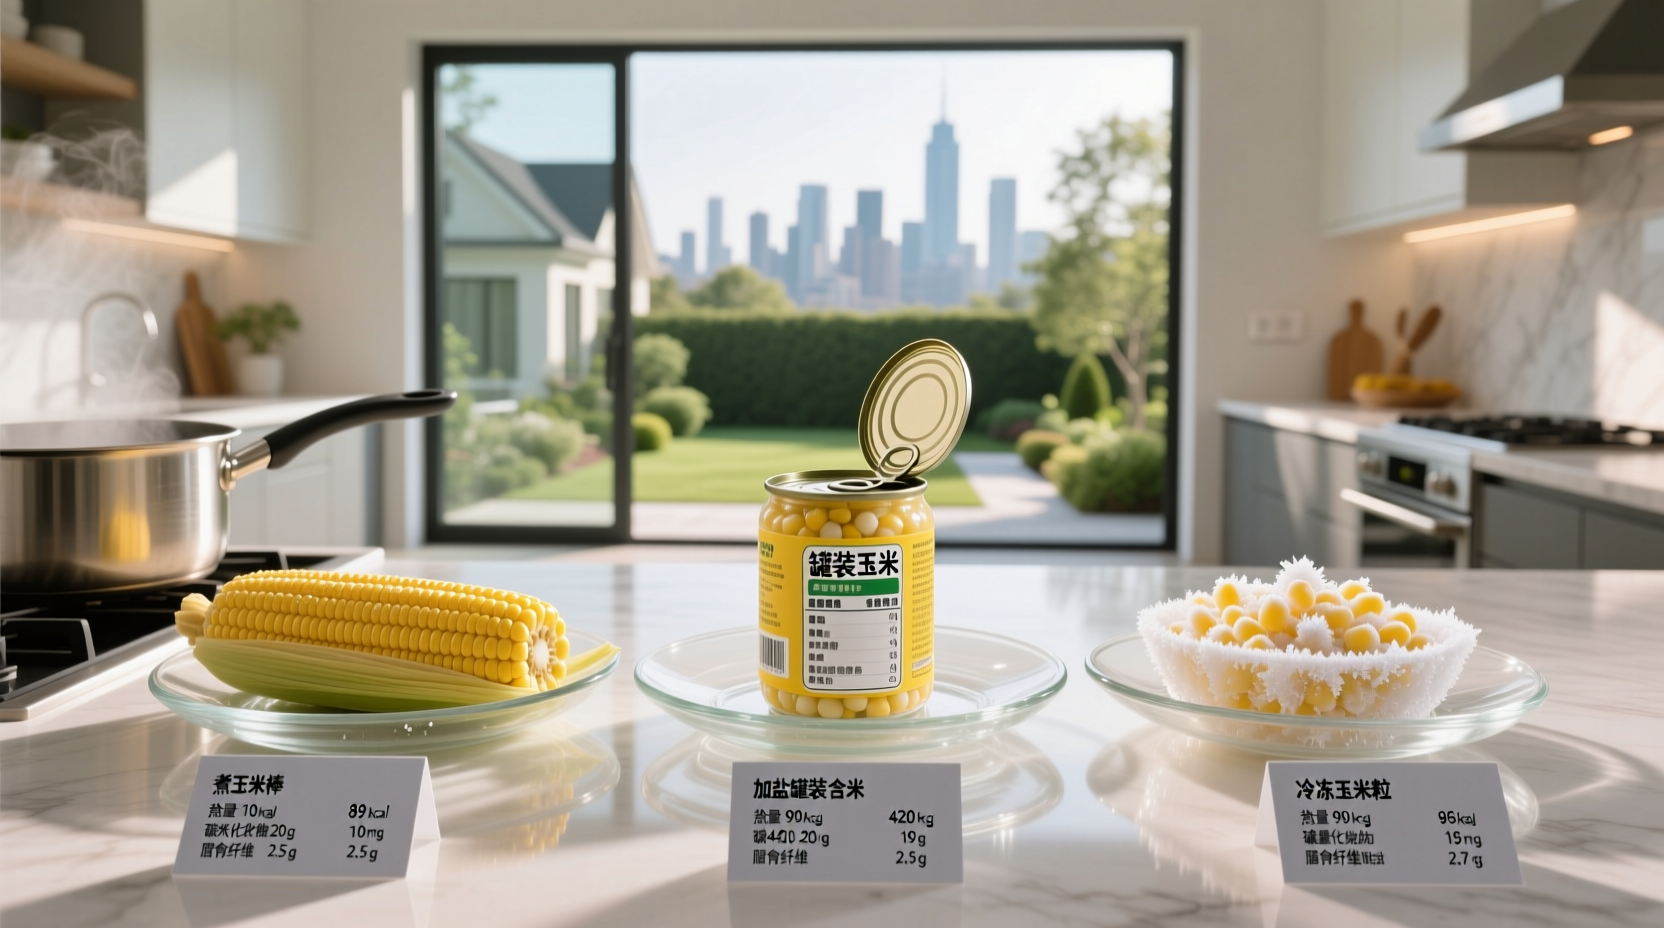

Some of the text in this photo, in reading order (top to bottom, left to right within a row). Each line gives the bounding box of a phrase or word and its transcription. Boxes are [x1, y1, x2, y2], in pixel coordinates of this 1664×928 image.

[808, 549, 899, 578] 罐装玉米
[212, 774, 284, 795] 煮玉米棒
[1296, 778, 1392, 800] 冷冻玉米粒
